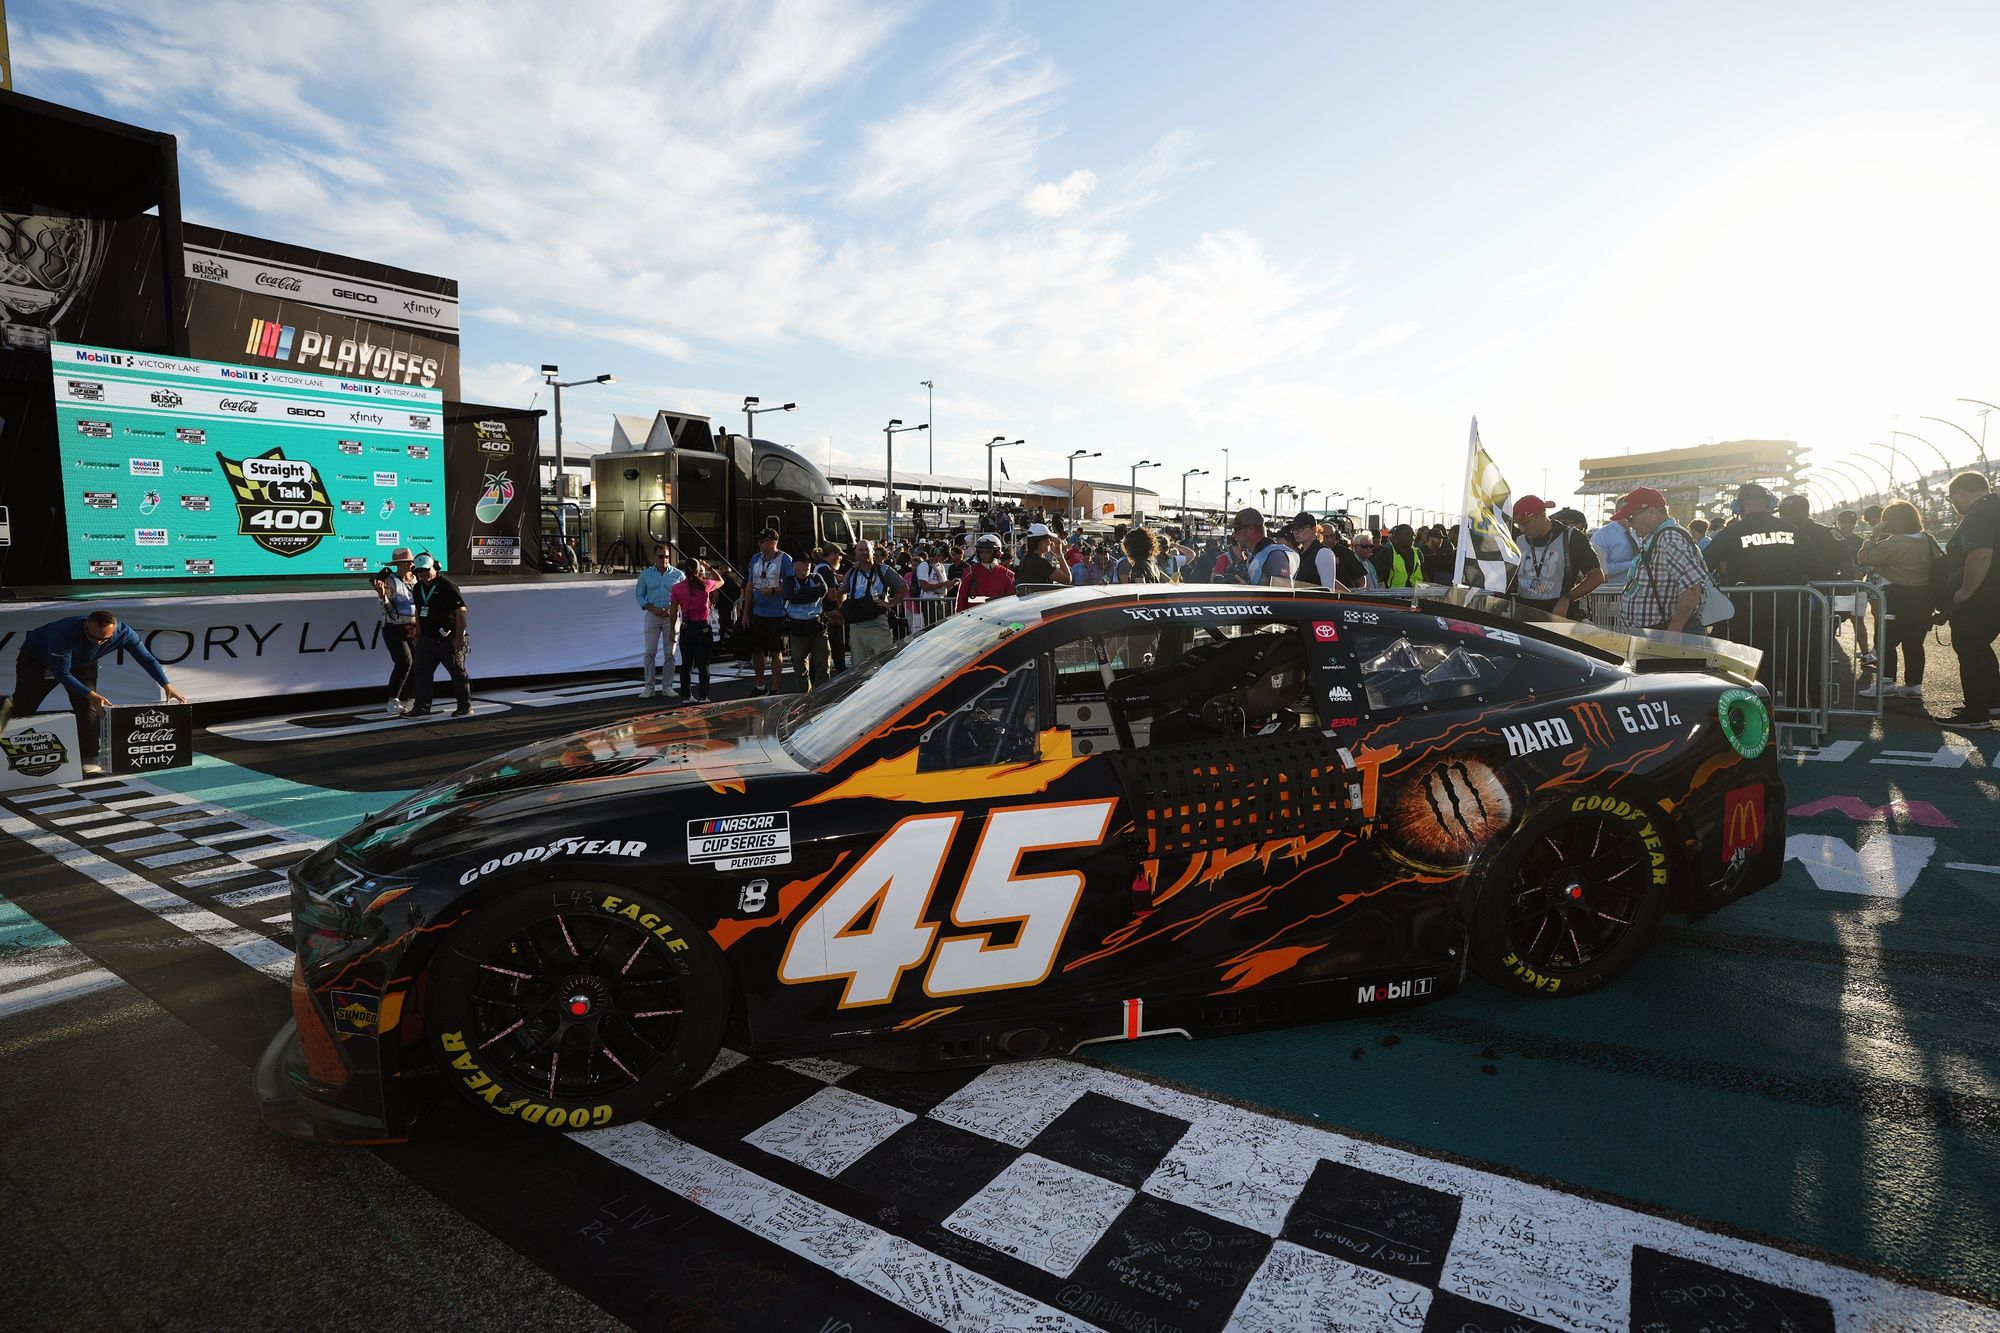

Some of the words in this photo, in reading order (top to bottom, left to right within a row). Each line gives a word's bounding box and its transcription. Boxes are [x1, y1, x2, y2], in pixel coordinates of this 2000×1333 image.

[192, 263, 229, 279] BUSCH
[255, 272, 303, 292] Coca-Cola
[332, 288, 378, 304] GEICO
[403, 301, 441, 318] xfinity
[76, 351, 109, 363] Mobil
[297, 330, 438, 388] PLAYOFFS
[138, 360, 176, 371] VICTORY
[178, 364, 200, 373] LANE
[221, 368, 248, 379] Mobil
[271, 375, 303, 384] VICTORY
[304, 378, 324, 387] LANE
[340, 383, 363, 392] Mobil
[150, 393, 183, 405] BUSCH
[383, 388, 410, 397] VICTORY
[410, 391, 427, 399] LANE
[219, 398, 259, 413] Coca-Cola
[287, 407, 325, 418] GEICO
[350, 411, 383, 425] xfinity
[482, 422, 503, 430] Straight
[482, 442, 510, 451] 400
[250, 462, 305, 478] Straight
[277, 486, 306, 499] Talk
[250, 510, 323, 529] 400
[486, 538, 514, 546] NASCAR
[1740, 531, 1795, 549] POLICE
[1150, 606, 1203, 618] TYLER
[1202, 605, 1273, 616] REDDICK
[1328, 686, 1352, 698] MAC
[135, 714, 169, 726] BUSCH
[1501, 717, 1574, 757] HARD
[1616, 700, 1682, 734] 6.0%
[14, 734, 48, 742] Straight
[127, 728, 177, 744] Coca-Cola
[128, 743, 177, 755] GEICO
[15, 753, 61, 766] 400
[131, 754, 174, 768] xfinity
[719, 815, 774, 832] NASCAR
[701, 838, 731, 853] CUP
[732, 834, 777, 851] SERIES
[1571, 795, 1668, 886] GOODYEAR
[459, 836, 648, 887] GOODYEAR
[730, 855, 777, 869] PLAYOFFS
[742, 878, 770, 913] 8
[776, 796, 1120, 1010] 45
[601, 895, 690, 955] EAGLE
[1502, 951, 1562, 993] EAGLE
[1358, 980, 1412, 1004] Mobil
[441, 1030, 613, 1129] GOODYEAR
